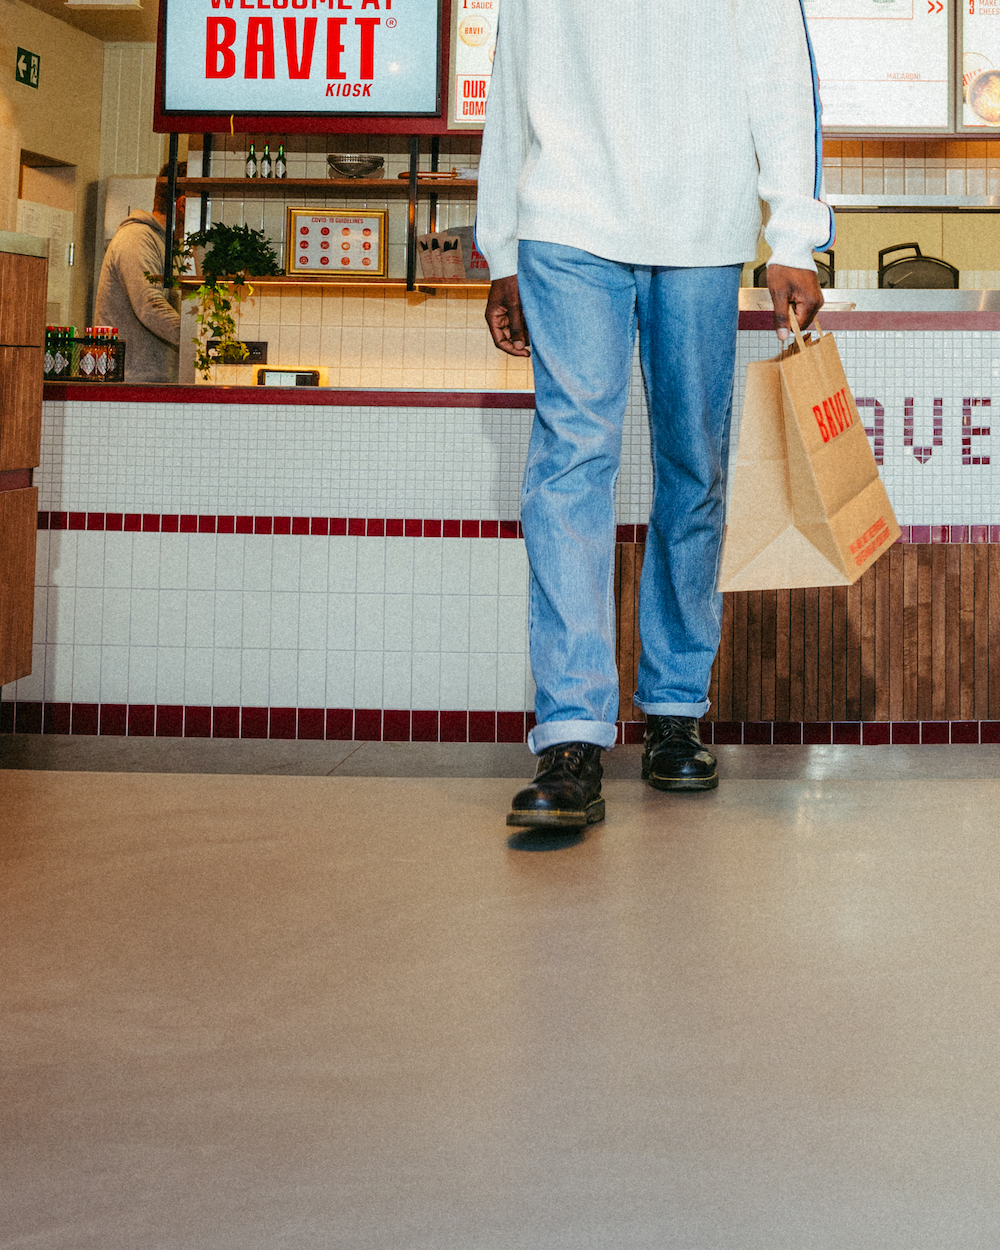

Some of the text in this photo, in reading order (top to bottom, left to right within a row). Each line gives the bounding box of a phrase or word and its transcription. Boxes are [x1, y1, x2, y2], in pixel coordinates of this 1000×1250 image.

[471, 2, 494, 10] SAUCE
[968, 0, 975, 15] 3
[978, 0, 998, 7] MAKE
[886, 72, 921, 81] MACARONI
[325, 83, 373, 97] KIOSK
[463, 80, 486, 99] OUR
